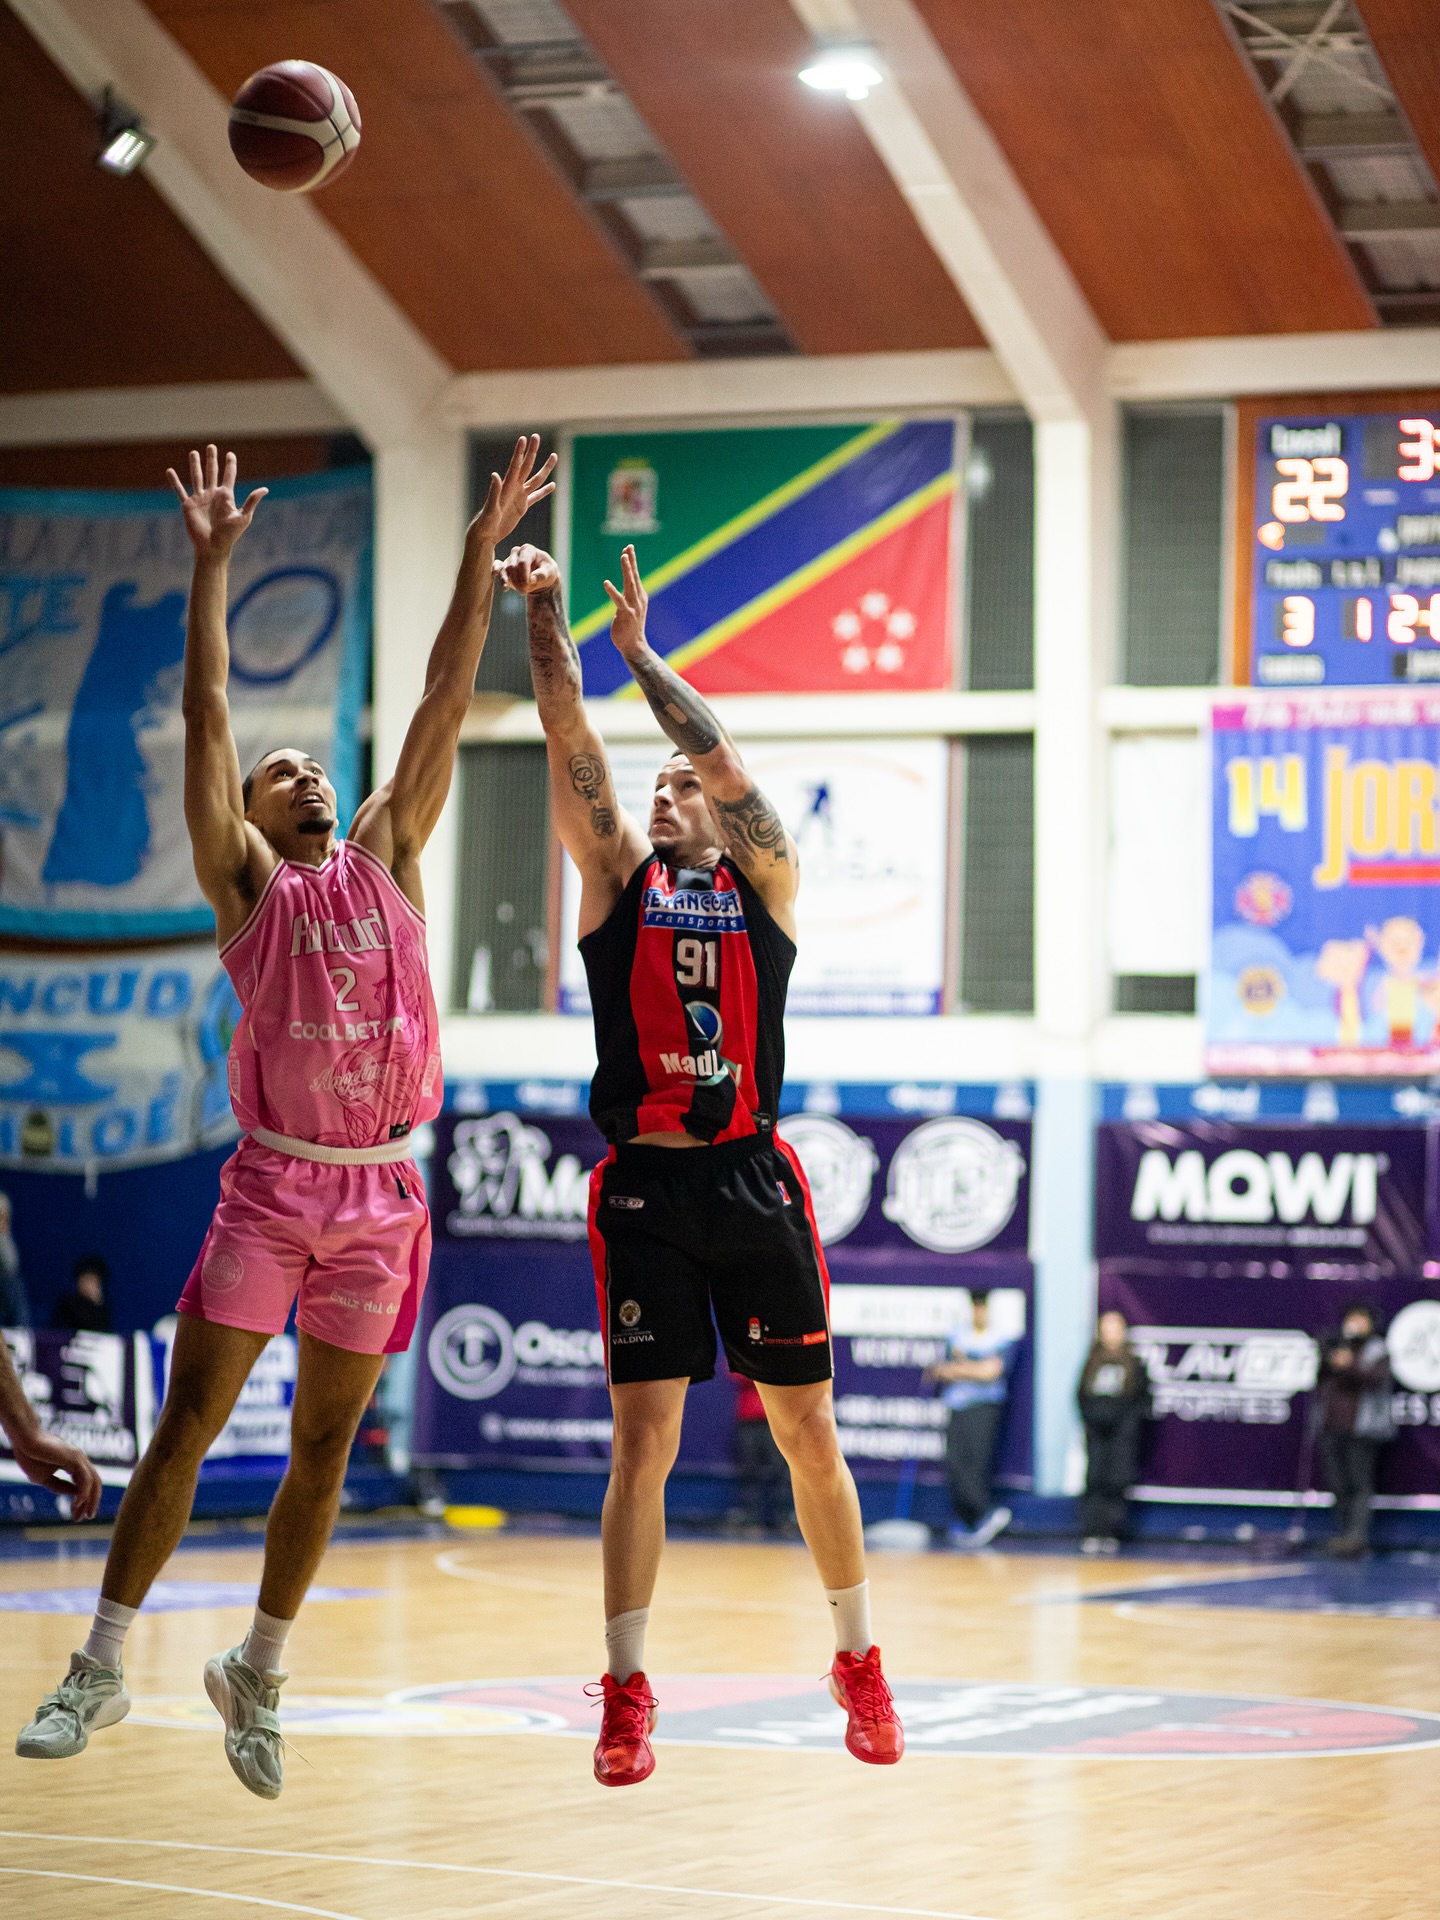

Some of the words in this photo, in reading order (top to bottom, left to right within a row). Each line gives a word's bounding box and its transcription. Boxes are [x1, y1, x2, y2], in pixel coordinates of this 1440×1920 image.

[1272, 457, 1349, 523] 22
[1283, 595, 1315, 647] 3
[1227, 754, 1309, 839] 14
[676, 938, 719, 988] 91
[329, 967, 360, 1011] 2
[288, 1020, 381, 1041] COOLBET
[612, 1334, 655, 1345] VALDIVIA
